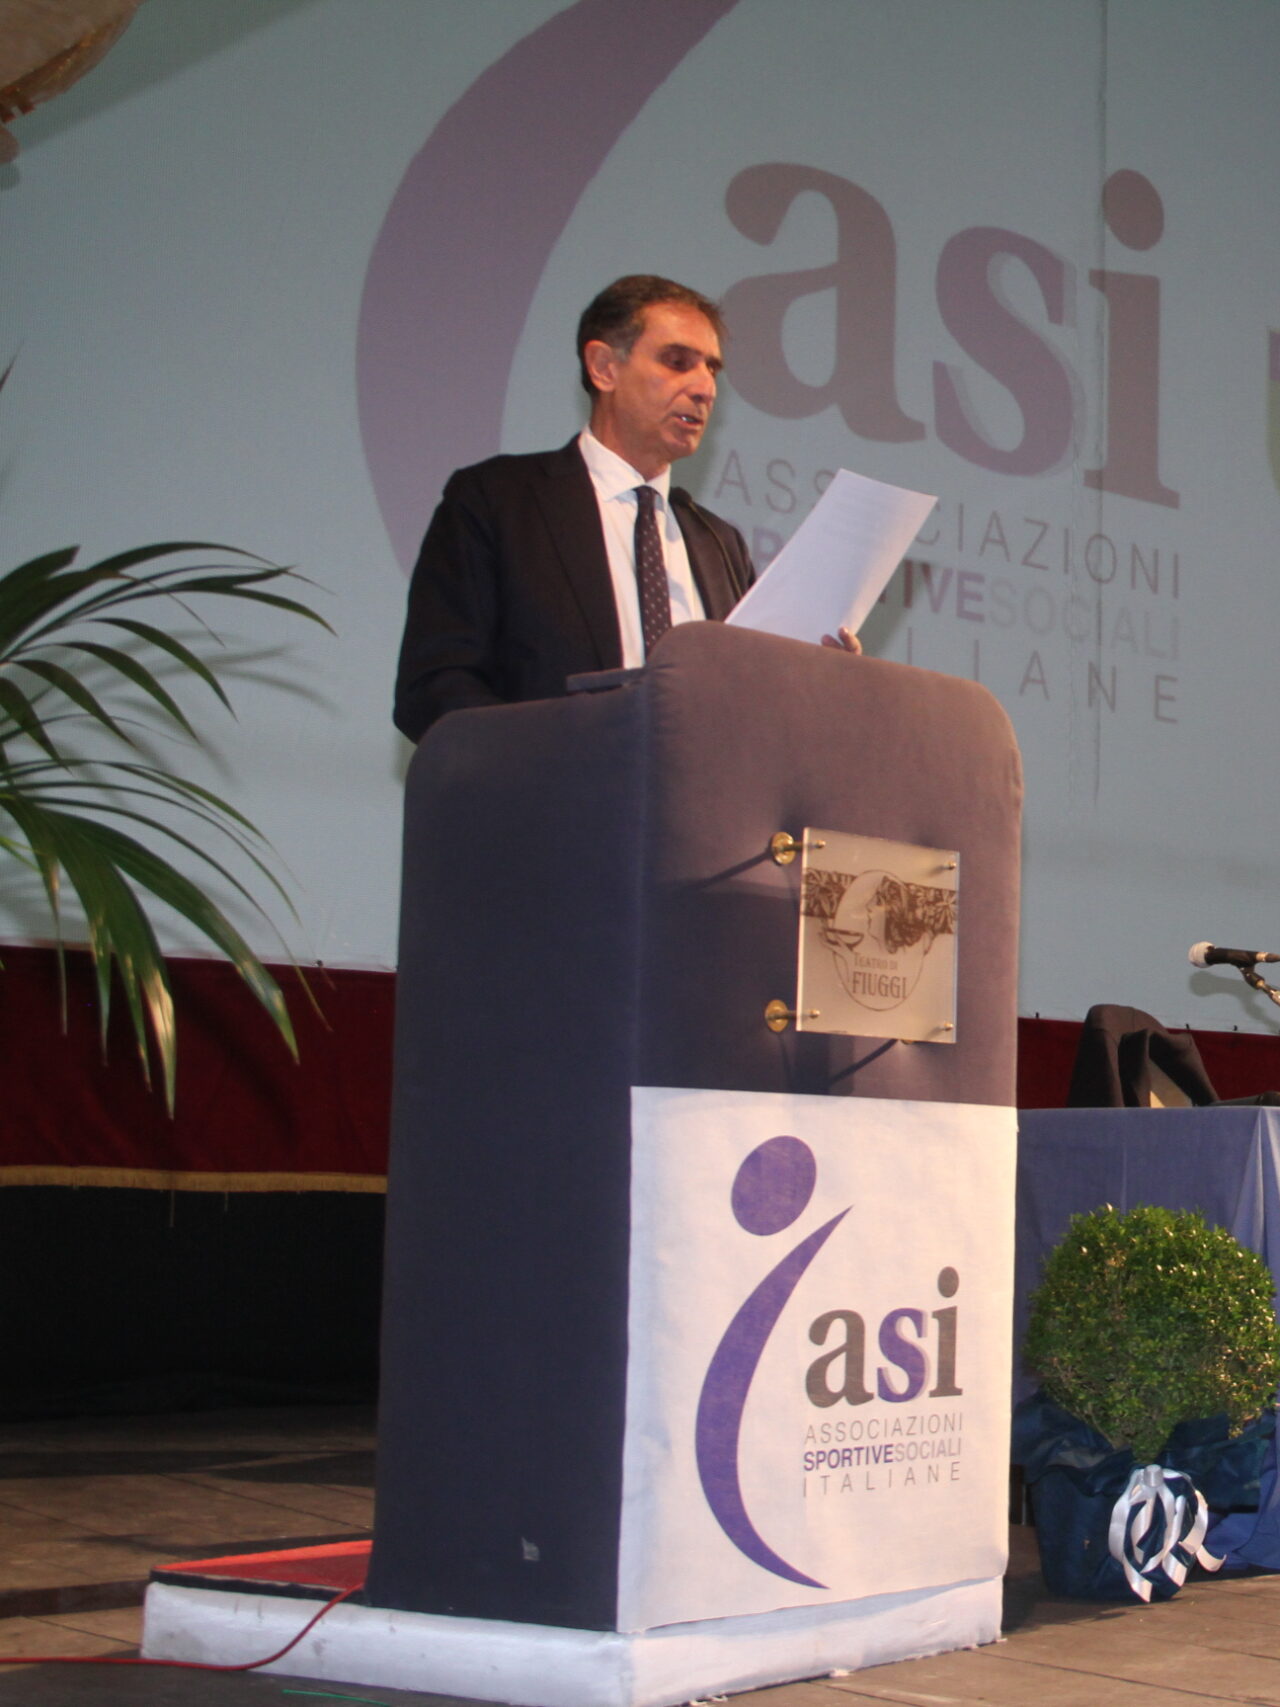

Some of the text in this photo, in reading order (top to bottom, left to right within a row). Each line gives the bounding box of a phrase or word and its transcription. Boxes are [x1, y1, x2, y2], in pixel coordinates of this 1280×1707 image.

[721, 161, 1181, 509] asi
[852, 971, 907, 999] FIUGGI
[805, 1266, 963, 1409] asi
[804, 1412, 963, 1446] ASSOCIAZIONI
[803, 1461, 961, 1498] ITALIANE
